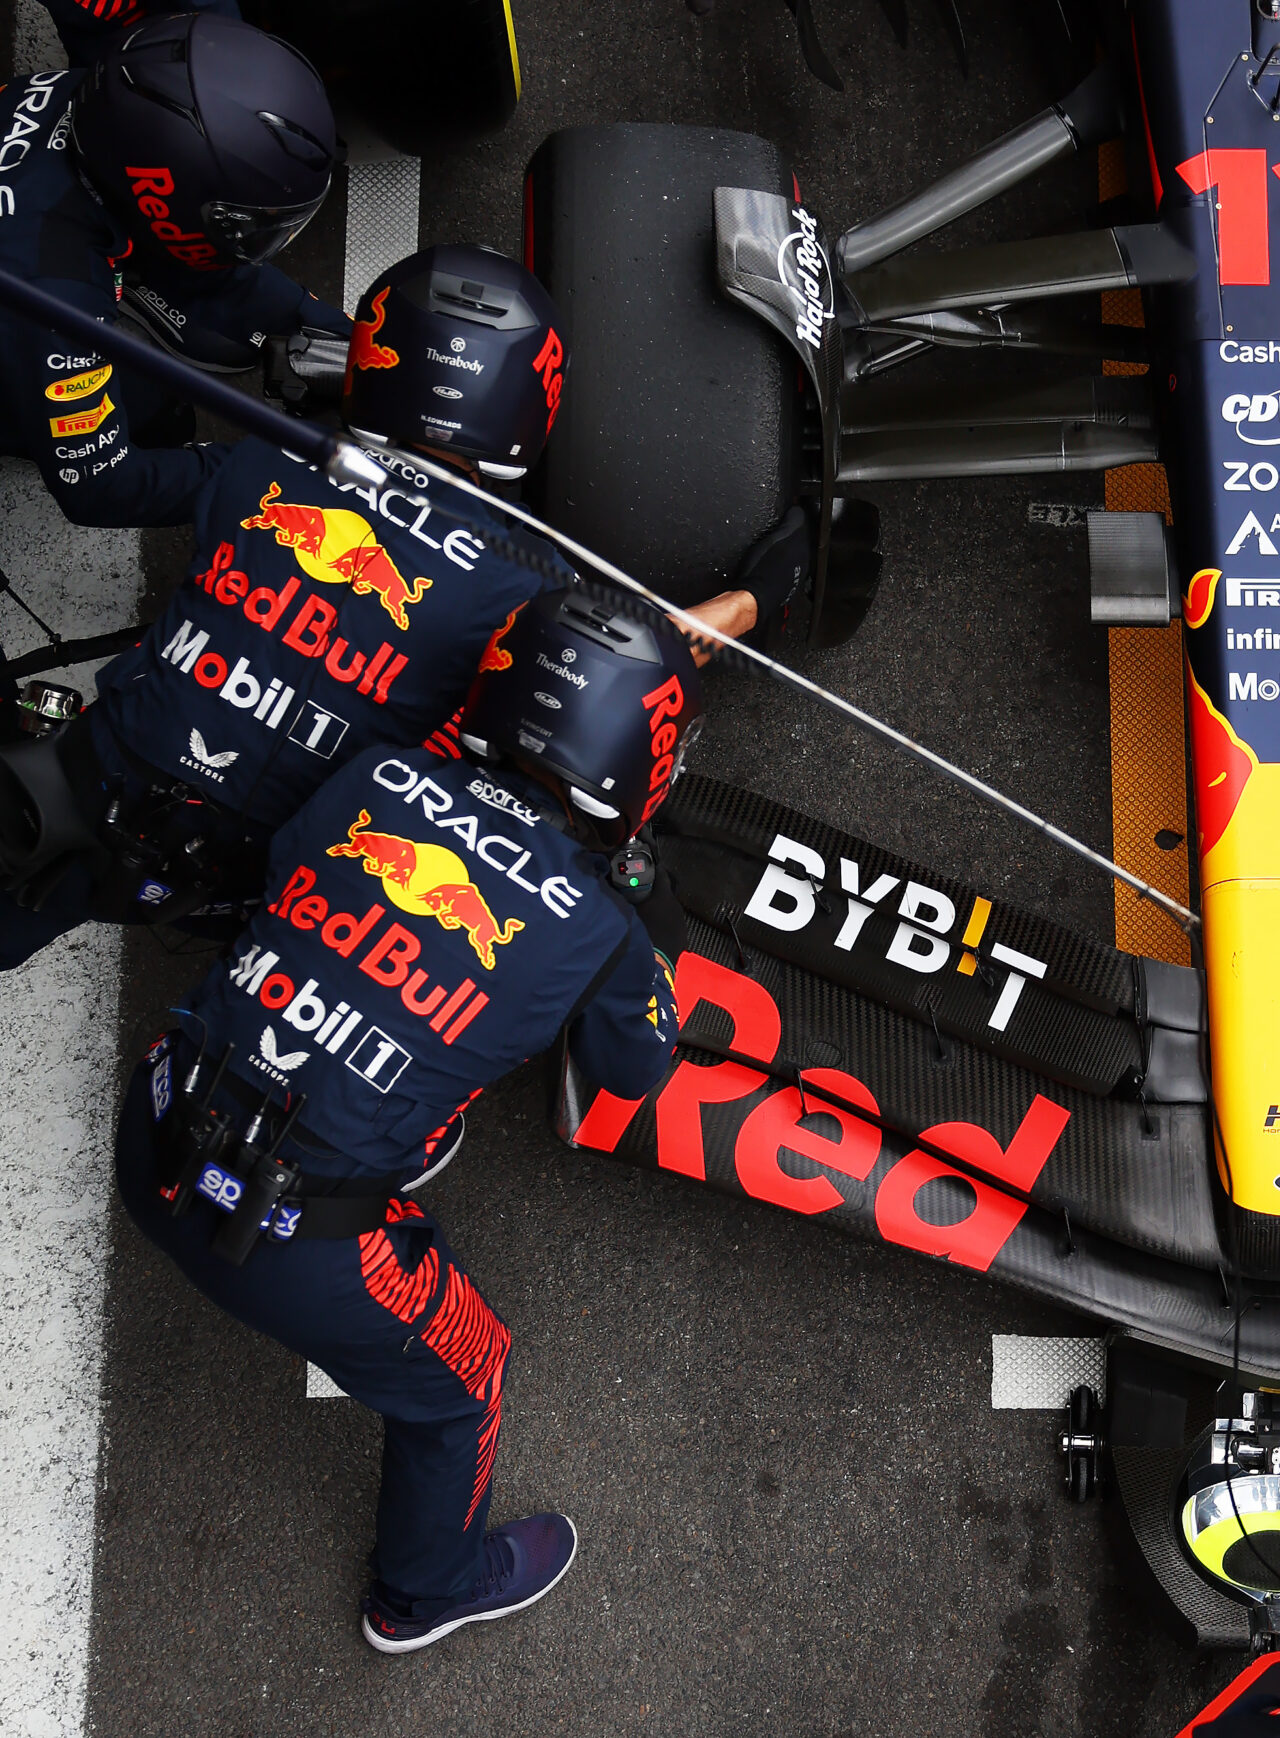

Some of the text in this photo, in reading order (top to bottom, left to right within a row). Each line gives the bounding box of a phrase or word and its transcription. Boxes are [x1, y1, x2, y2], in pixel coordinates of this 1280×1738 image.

[791, 207, 825, 349] Hard Rock
[66, 368, 106, 394] RAUCH
[426, 347, 485, 376] Therabody
[55, 443, 96, 459] Cash
[160, 620, 296, 731] Mobil
[195, 541, 409, 705] Red Bull
[536, 652, 590, 690] Therabody
[179, 755, 226, 783] CASTORE
[372, 758, 584, 919] ORACLE
[229, 944, 364, 1055] Mobil
[267, 865, 490, 1046] Red Bull
[571, 950, 1073, 1272] Red
